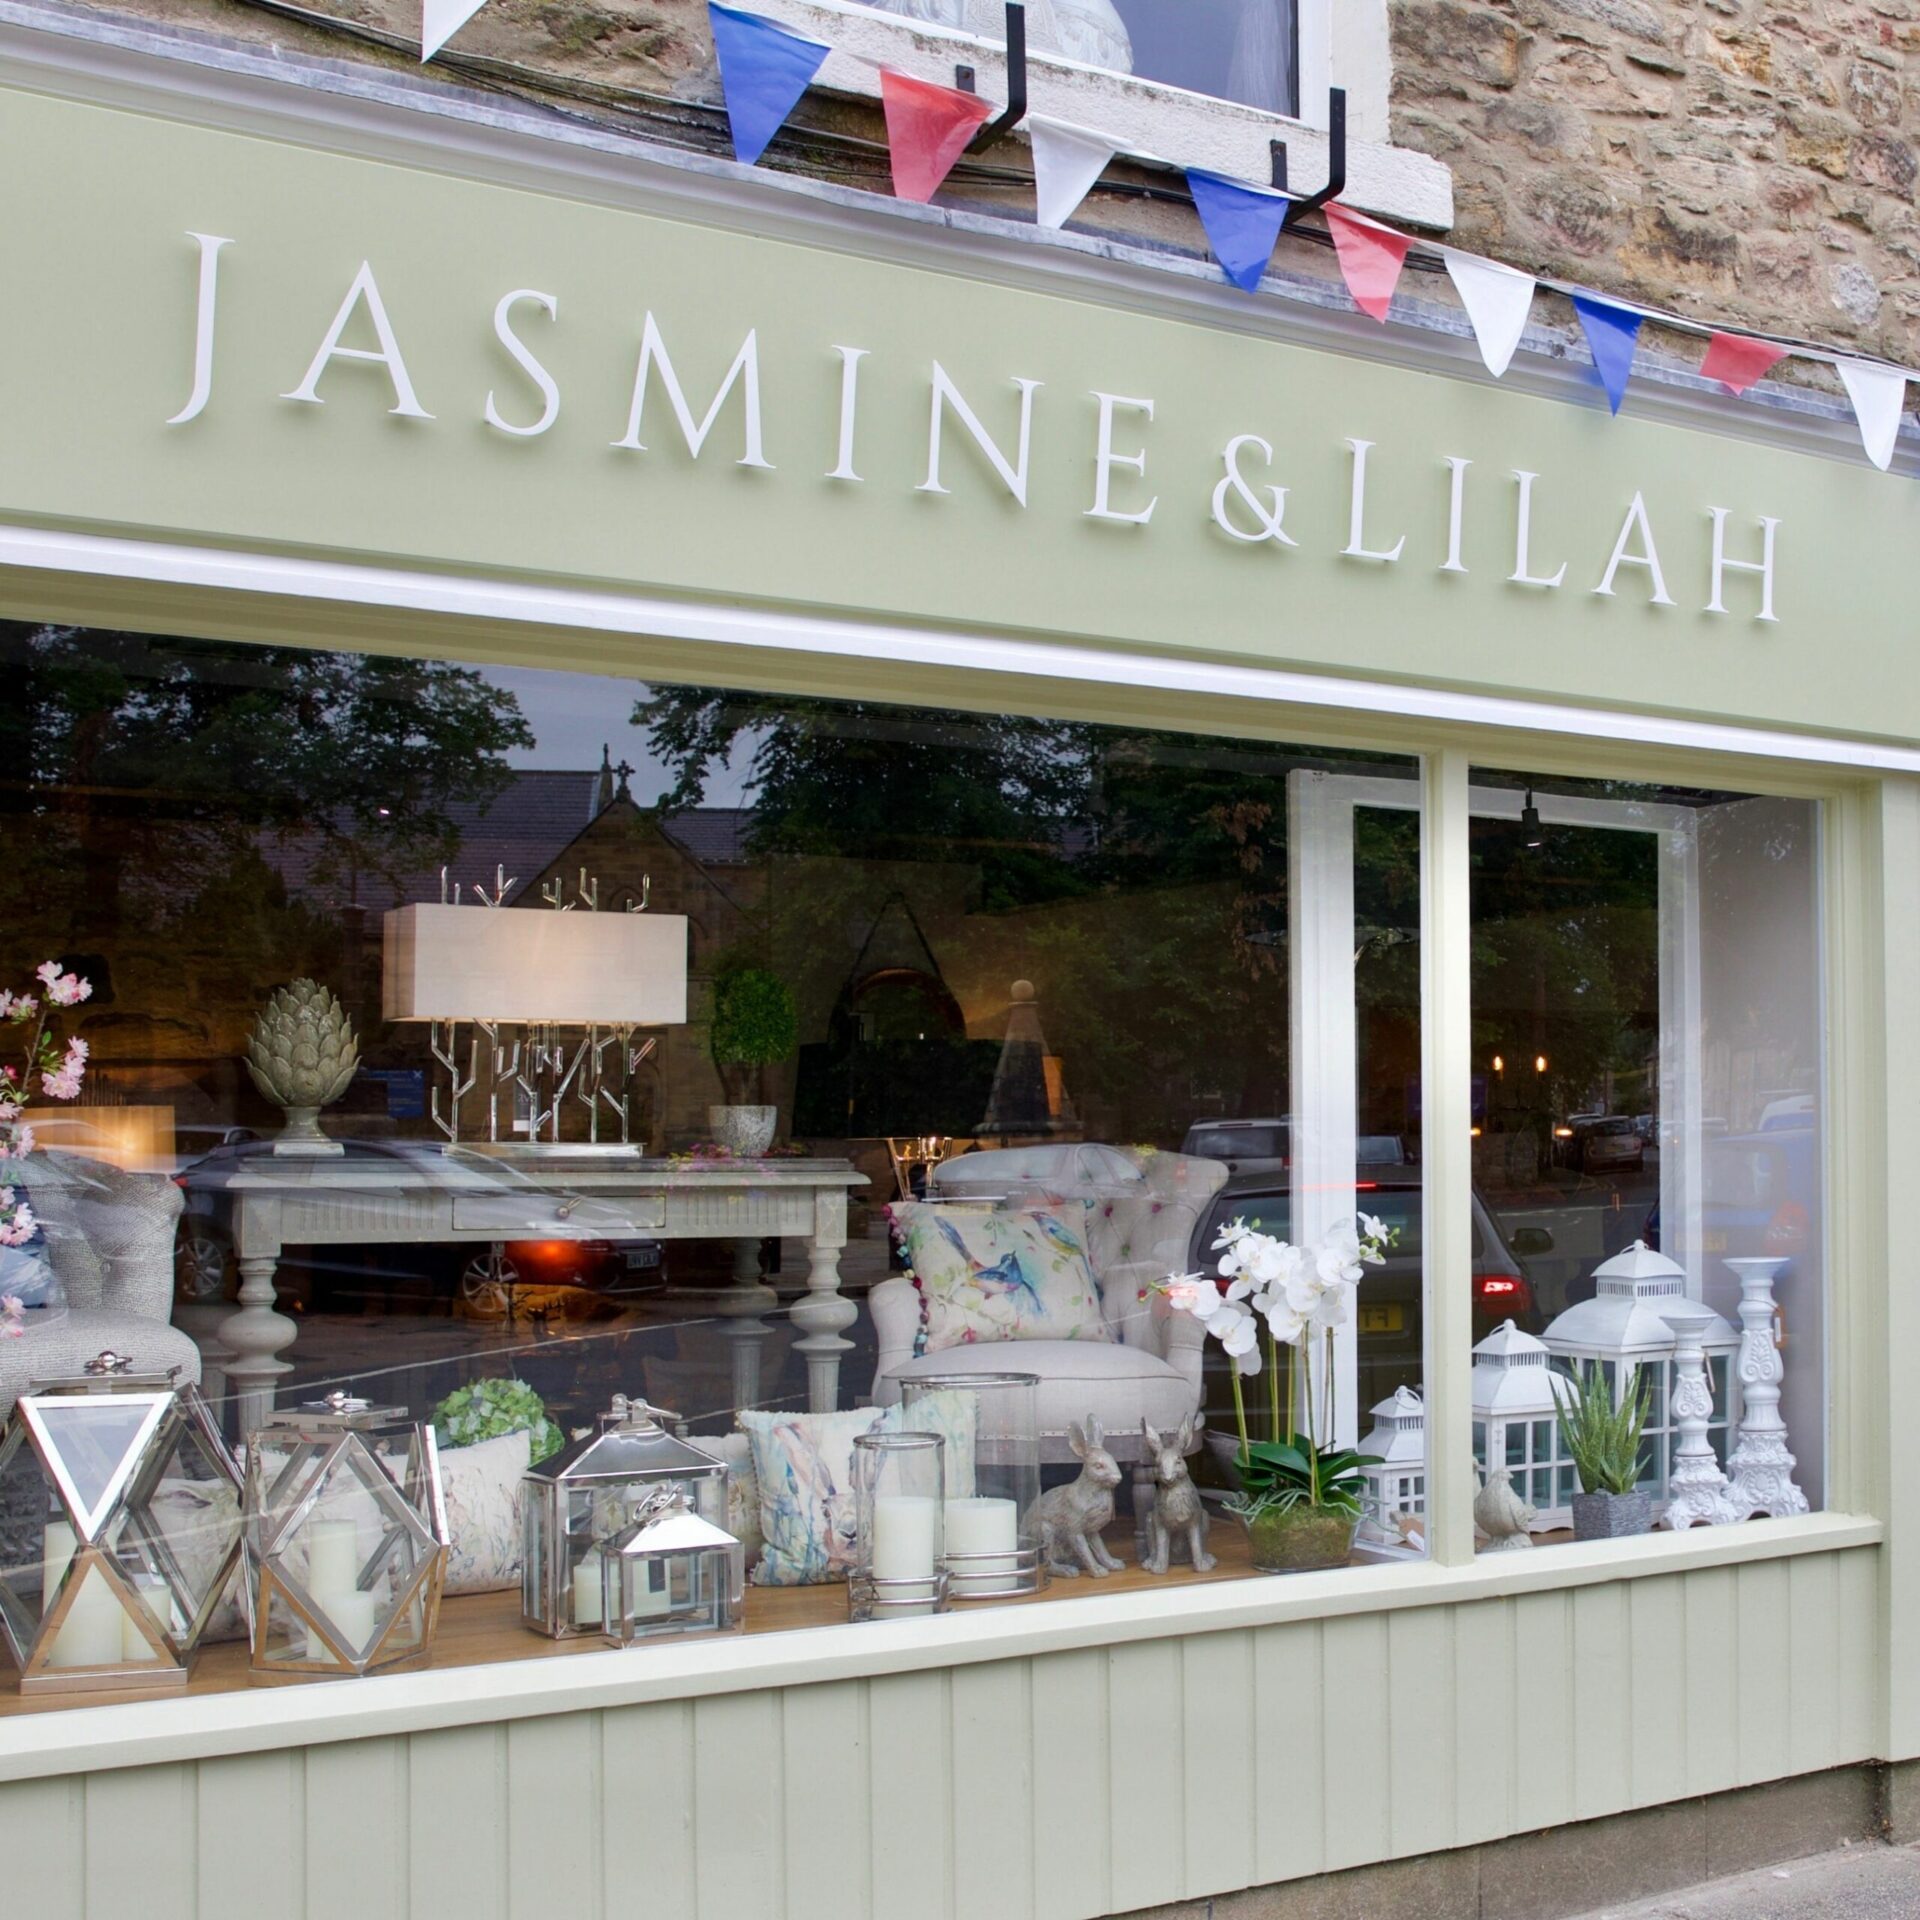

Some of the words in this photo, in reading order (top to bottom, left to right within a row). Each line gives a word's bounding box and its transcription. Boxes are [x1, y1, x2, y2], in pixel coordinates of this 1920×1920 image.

[166, 231, 1158, 524] JASMINE
[1212, 434, 1299, 546] &
[1339, 438, 1782, 622] LILAH
